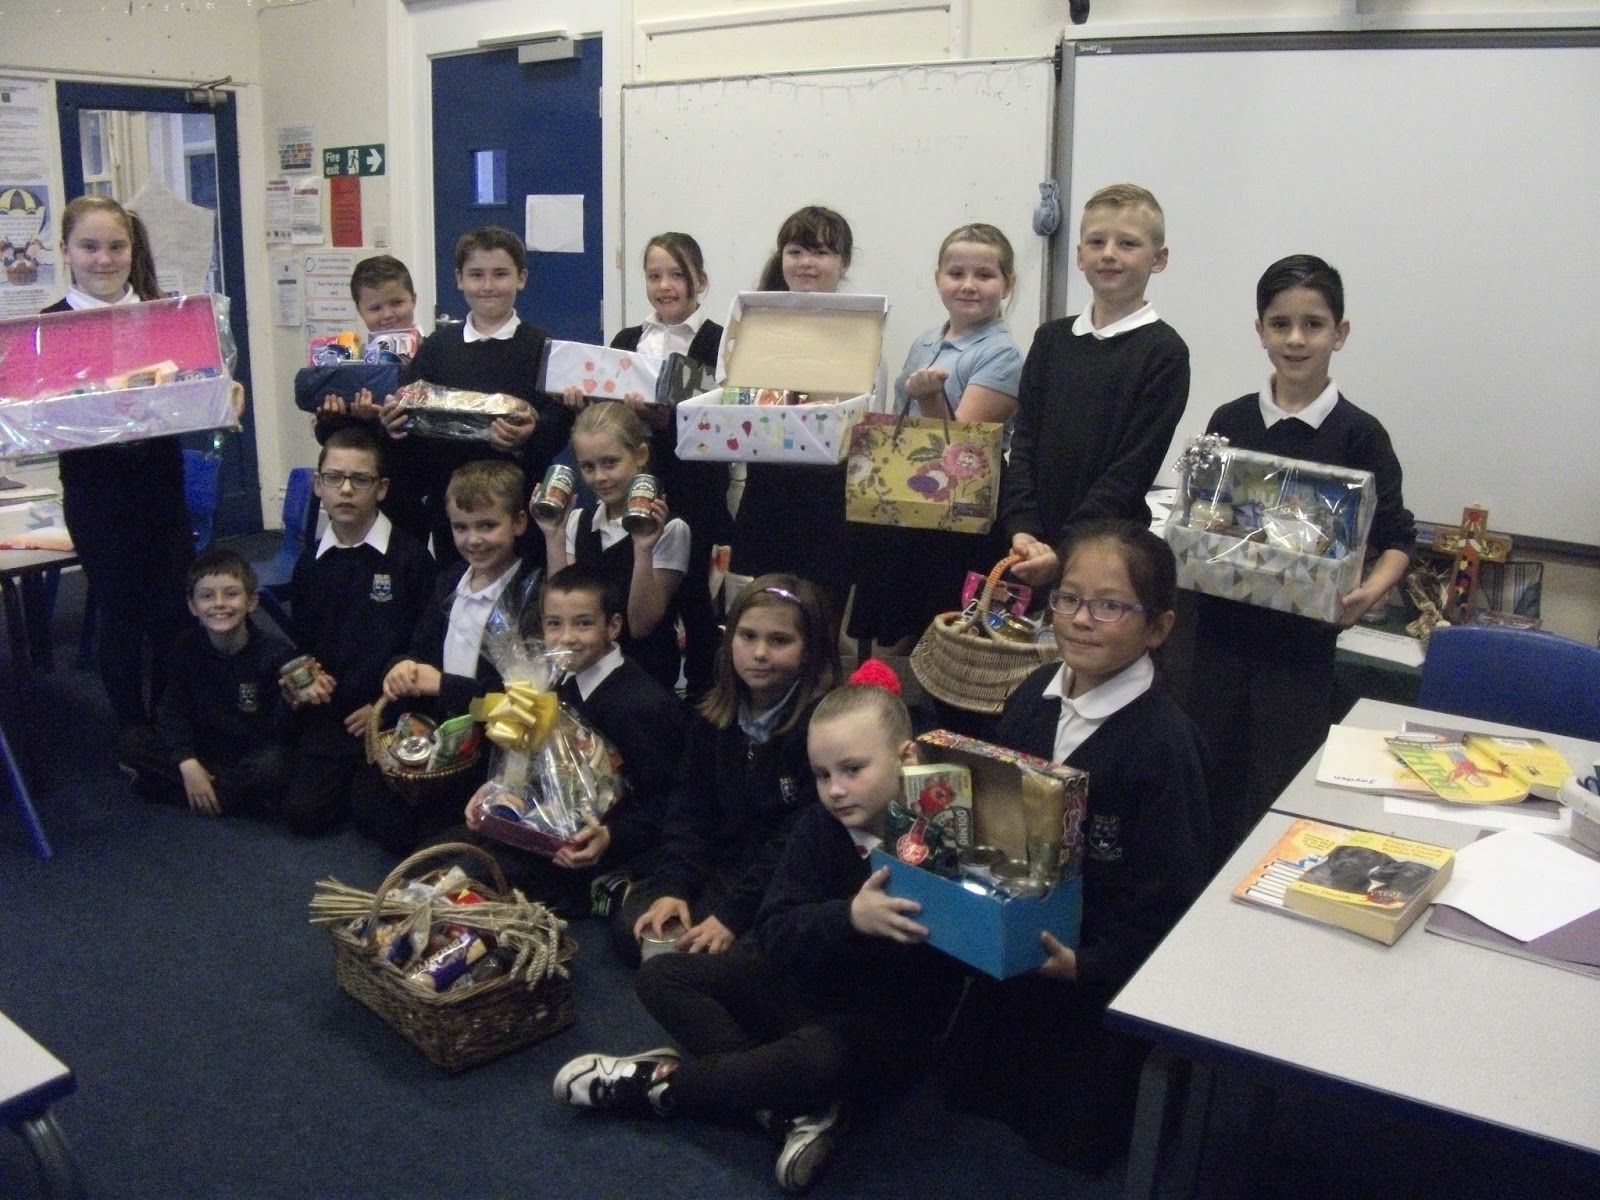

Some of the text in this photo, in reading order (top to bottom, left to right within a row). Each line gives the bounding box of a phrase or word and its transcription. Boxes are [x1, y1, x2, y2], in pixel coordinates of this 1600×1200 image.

[325, 152, 340, 163] Fire
[325, 164, 340, 175] exit
[956, 810, 967, 846] DOLMIO
